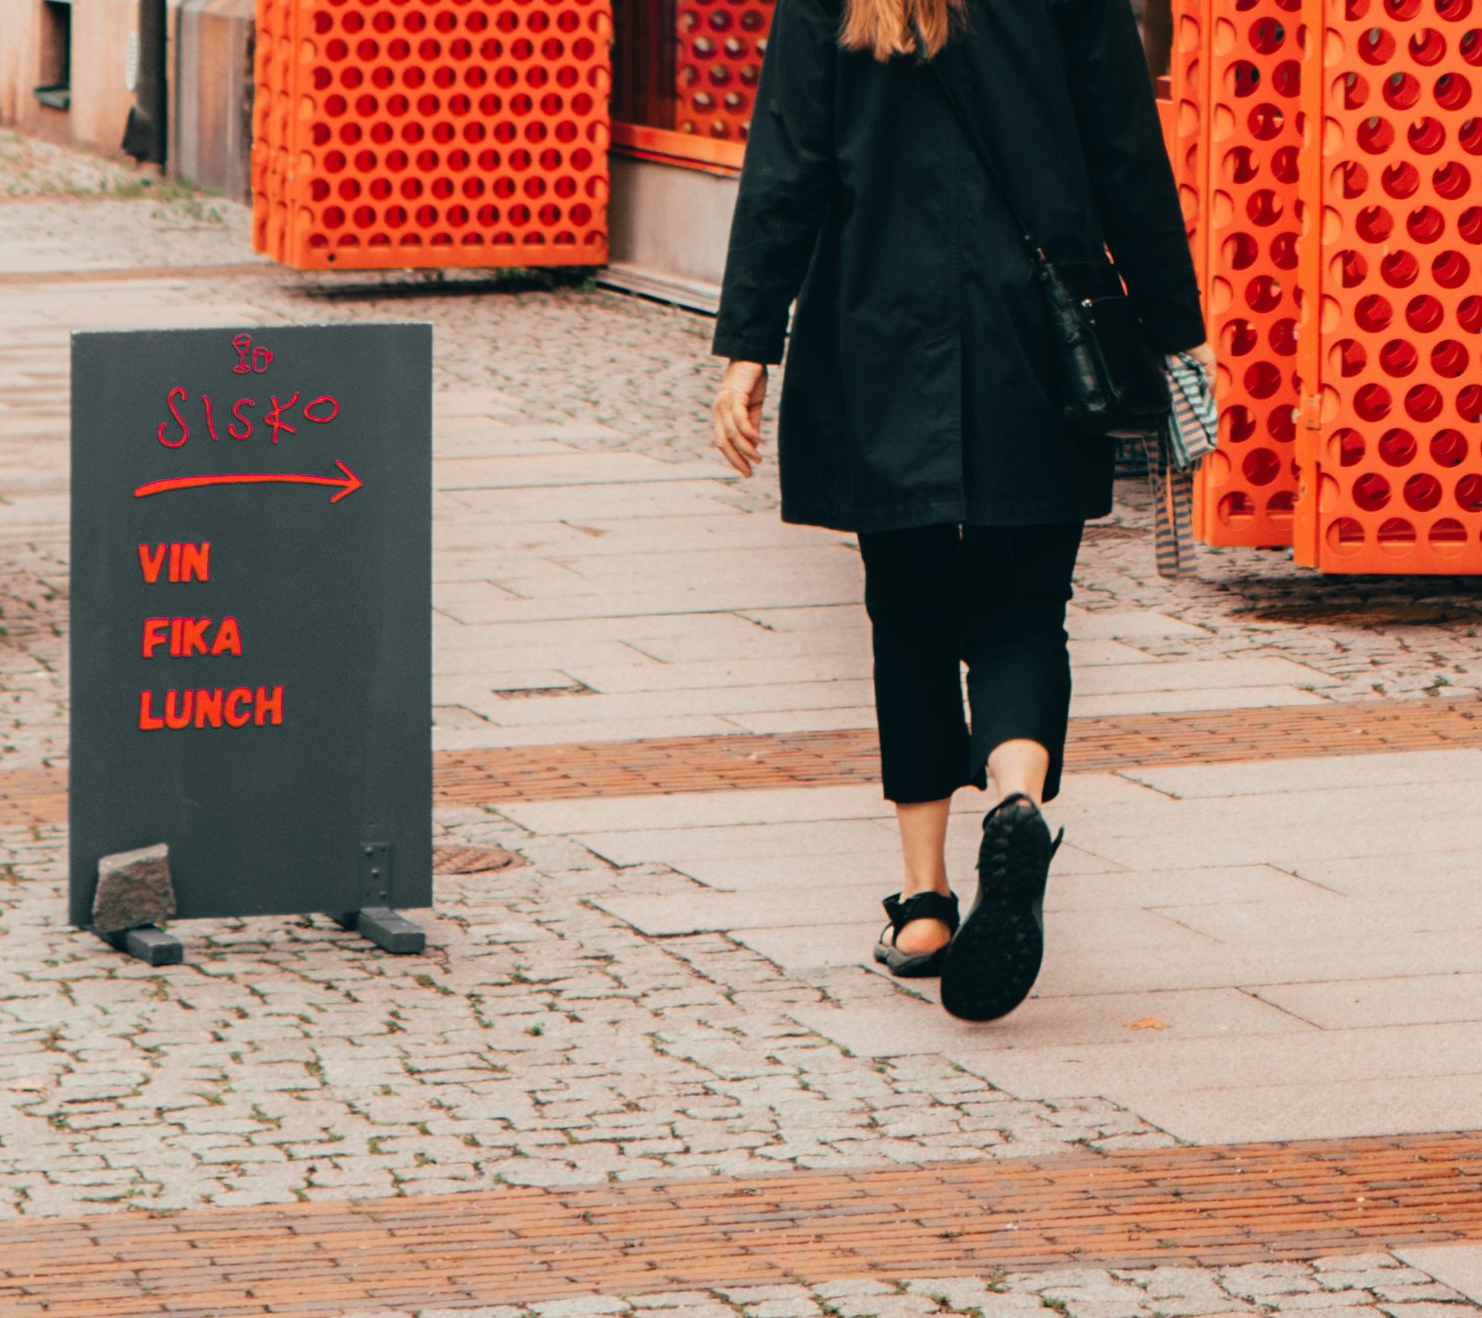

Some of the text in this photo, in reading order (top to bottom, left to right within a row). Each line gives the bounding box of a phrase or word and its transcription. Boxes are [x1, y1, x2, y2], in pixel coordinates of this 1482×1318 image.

[138, 541, 211, 583] VIN
[142, 615, 243, 659] FIKA
[138, 684, 285, 731] LUNCH
